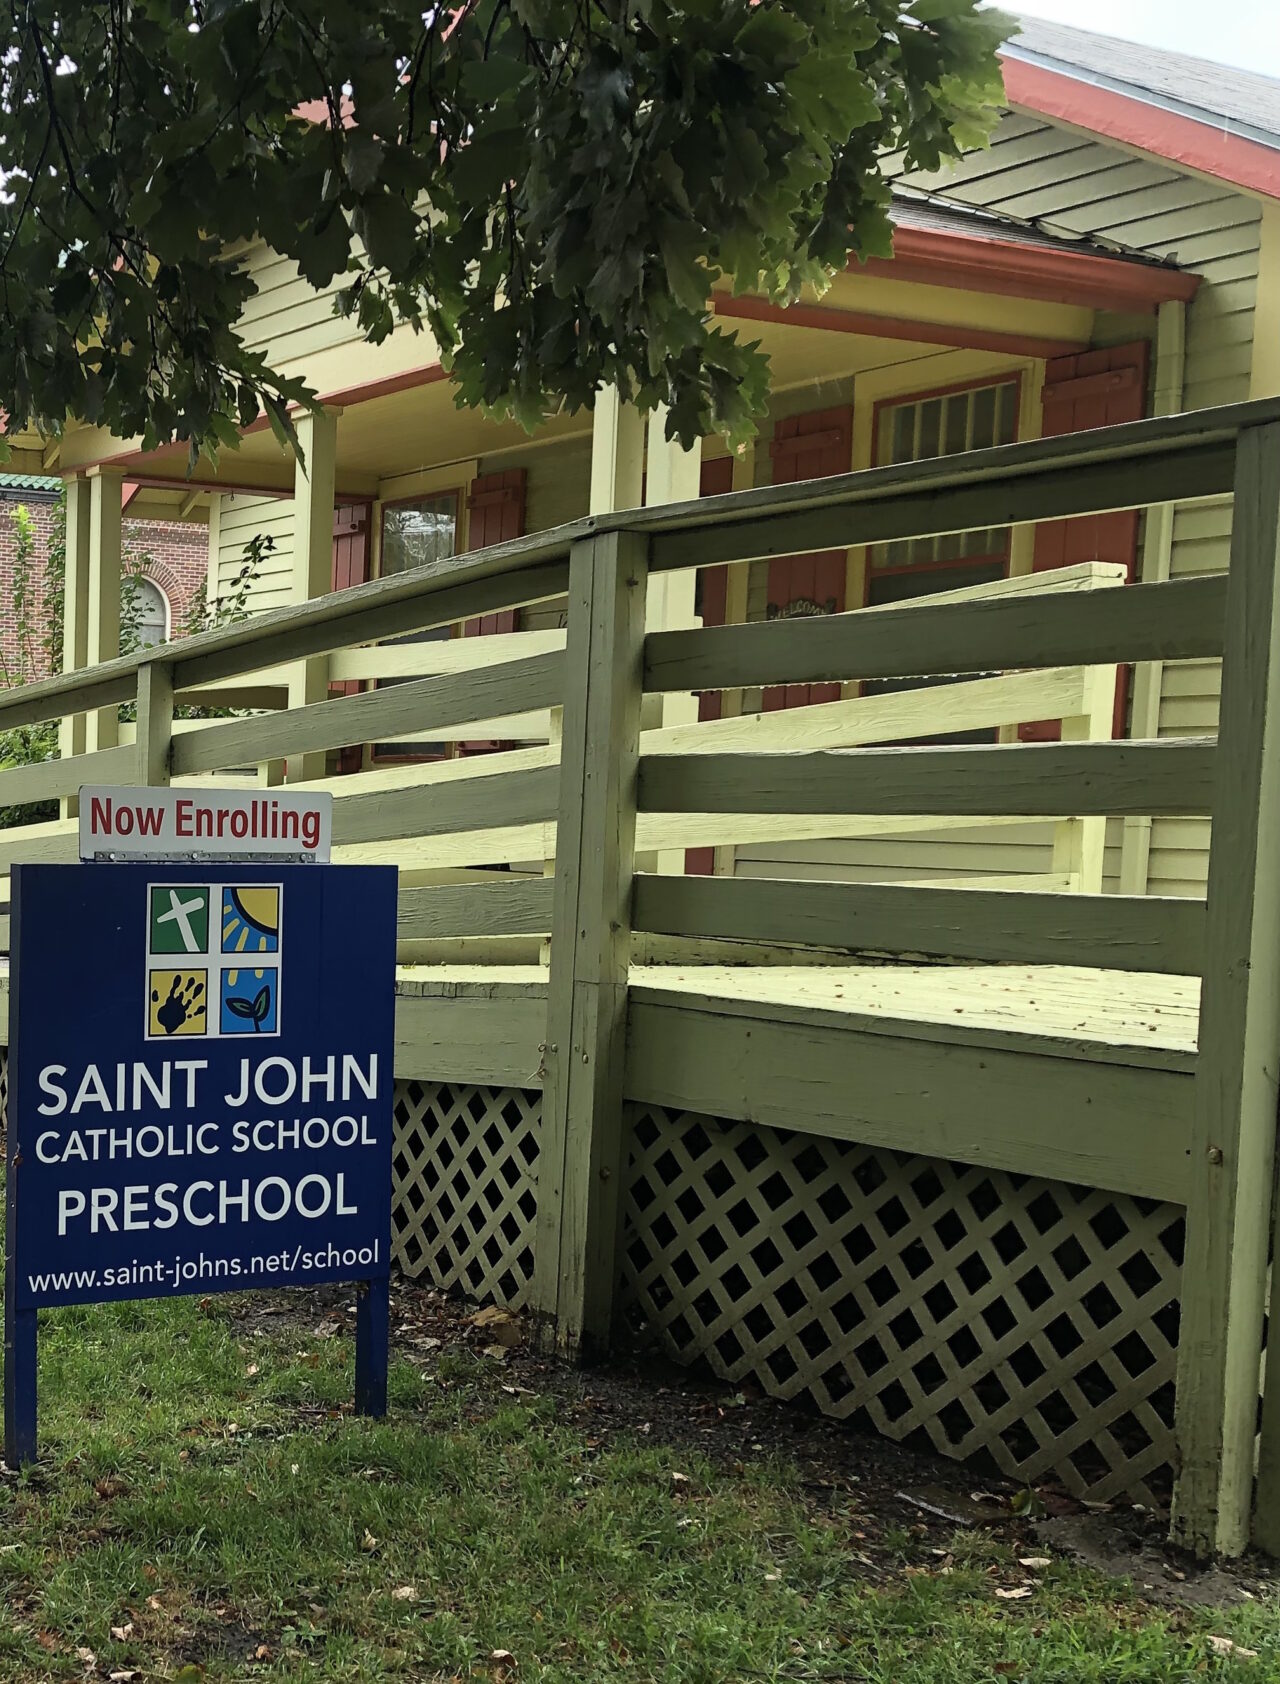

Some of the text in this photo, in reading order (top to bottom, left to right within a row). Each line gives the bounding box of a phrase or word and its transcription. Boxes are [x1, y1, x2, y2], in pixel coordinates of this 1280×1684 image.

[90, 797, 320, 849] Now Enrolling
[37, 1053, 378, 1116] SAINT JOHN
[35, 1115, 377, 1164] CATHOLIC SCHOOL
[58, 1172, 357, 1236] PRESCHOOL
[28, 1239, 379, 1293] www.saint-johns.net/school
